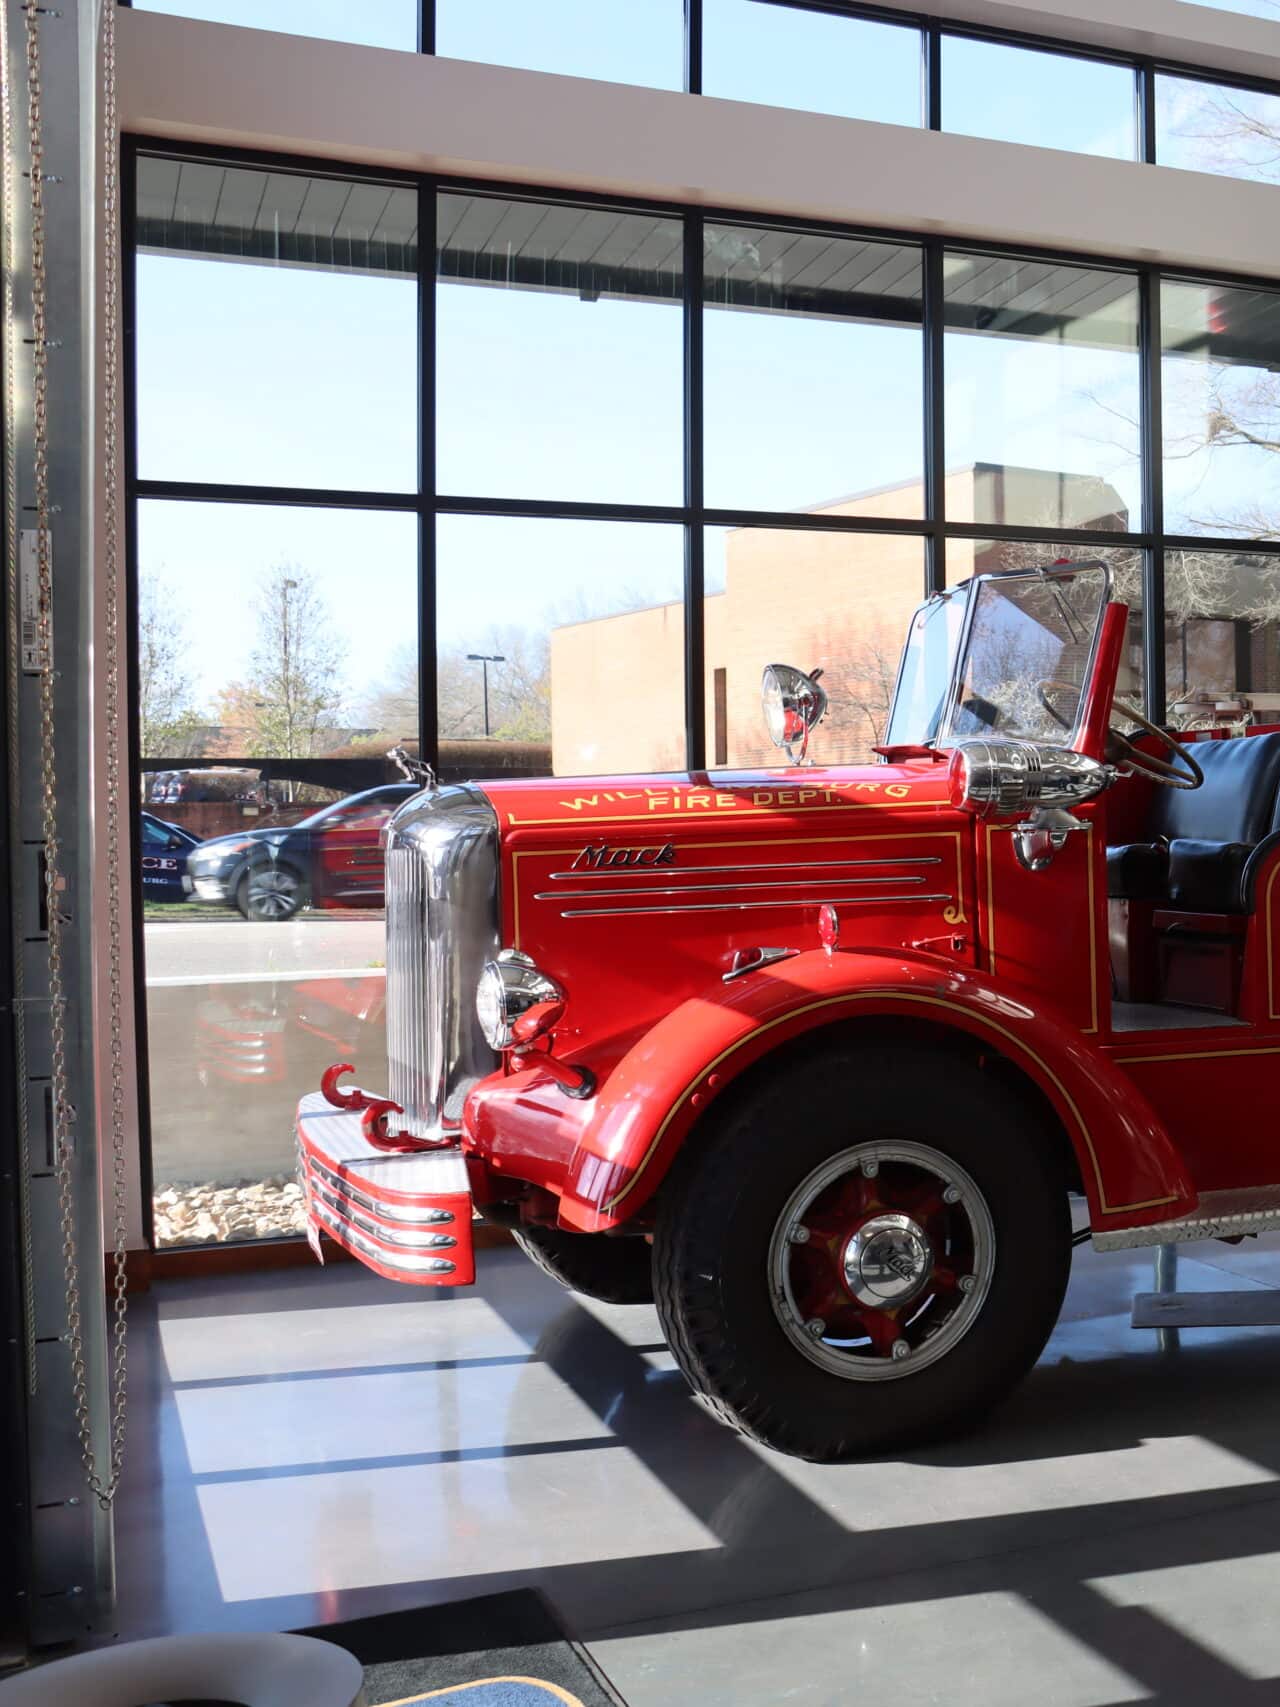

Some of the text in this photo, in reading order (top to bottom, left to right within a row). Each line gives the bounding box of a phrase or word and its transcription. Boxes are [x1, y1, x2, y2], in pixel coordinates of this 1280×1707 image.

[648, 789, 843, 811] FIRE DEPT.
[571, 843, 674, 869] Mack
